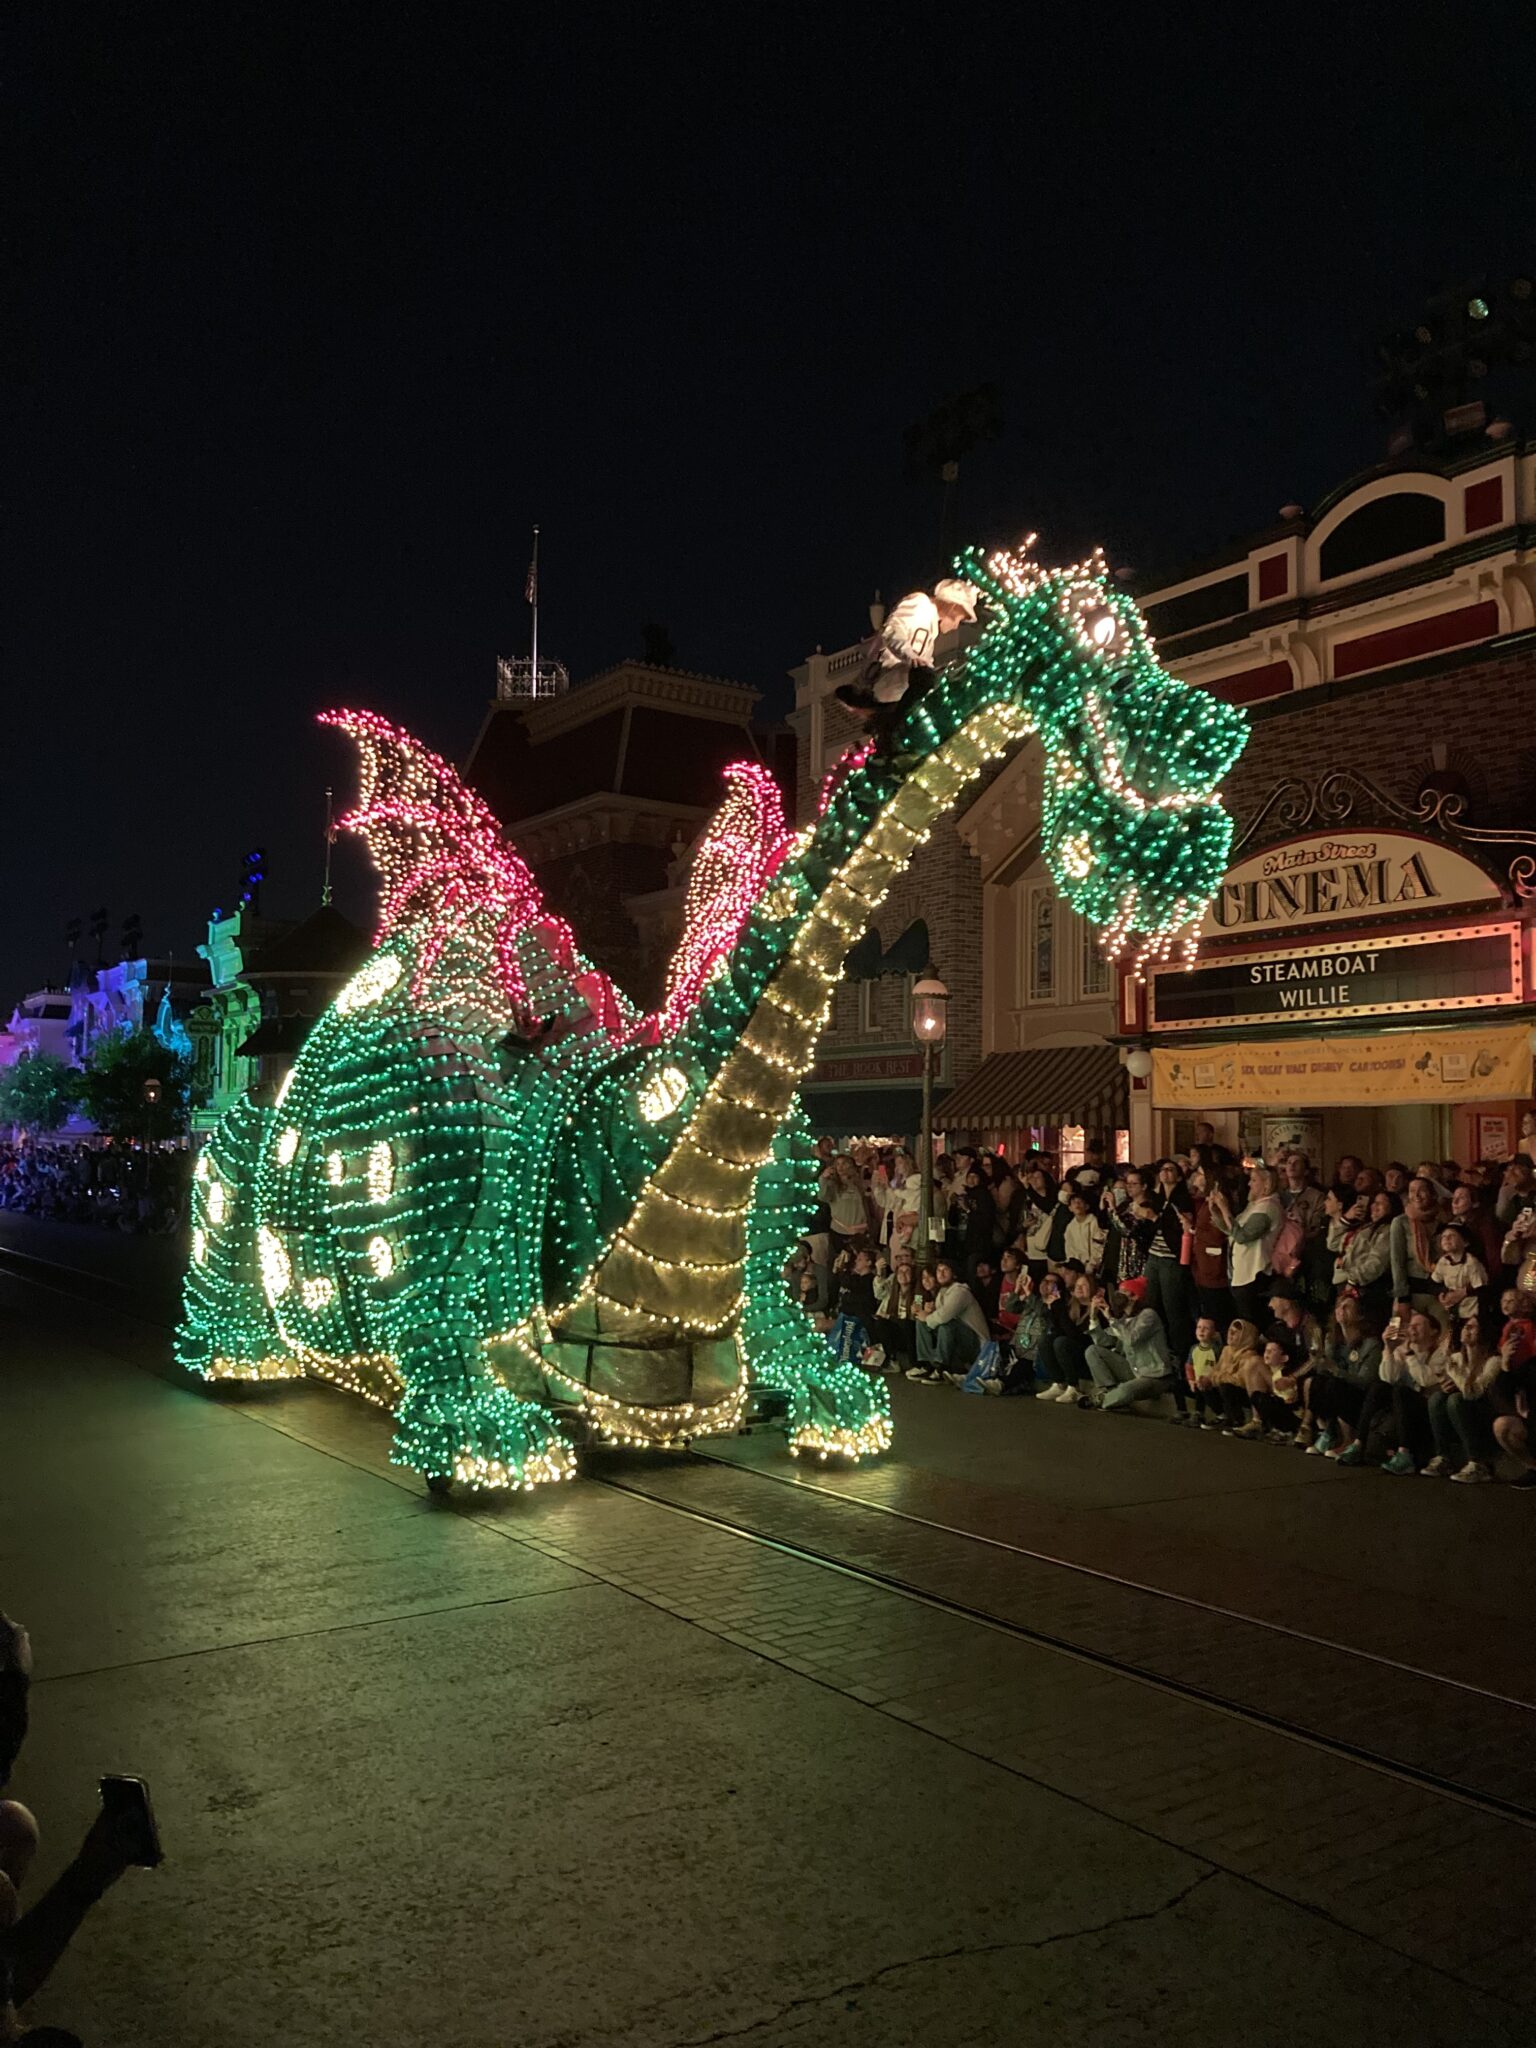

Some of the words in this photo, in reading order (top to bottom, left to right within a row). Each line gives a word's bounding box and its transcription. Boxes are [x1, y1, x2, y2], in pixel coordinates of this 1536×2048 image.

[1263, 850, 1317, 876] Main
[1317, 842, 1376, 862] Street
[1212, 851, 1441, 928] CINEMA
[1250, 953, 1379, 984] STEAMBOAT
[1279, 985, 1350, 1008] WILLIE
[854, 1062, 882, 1074] BOOK
